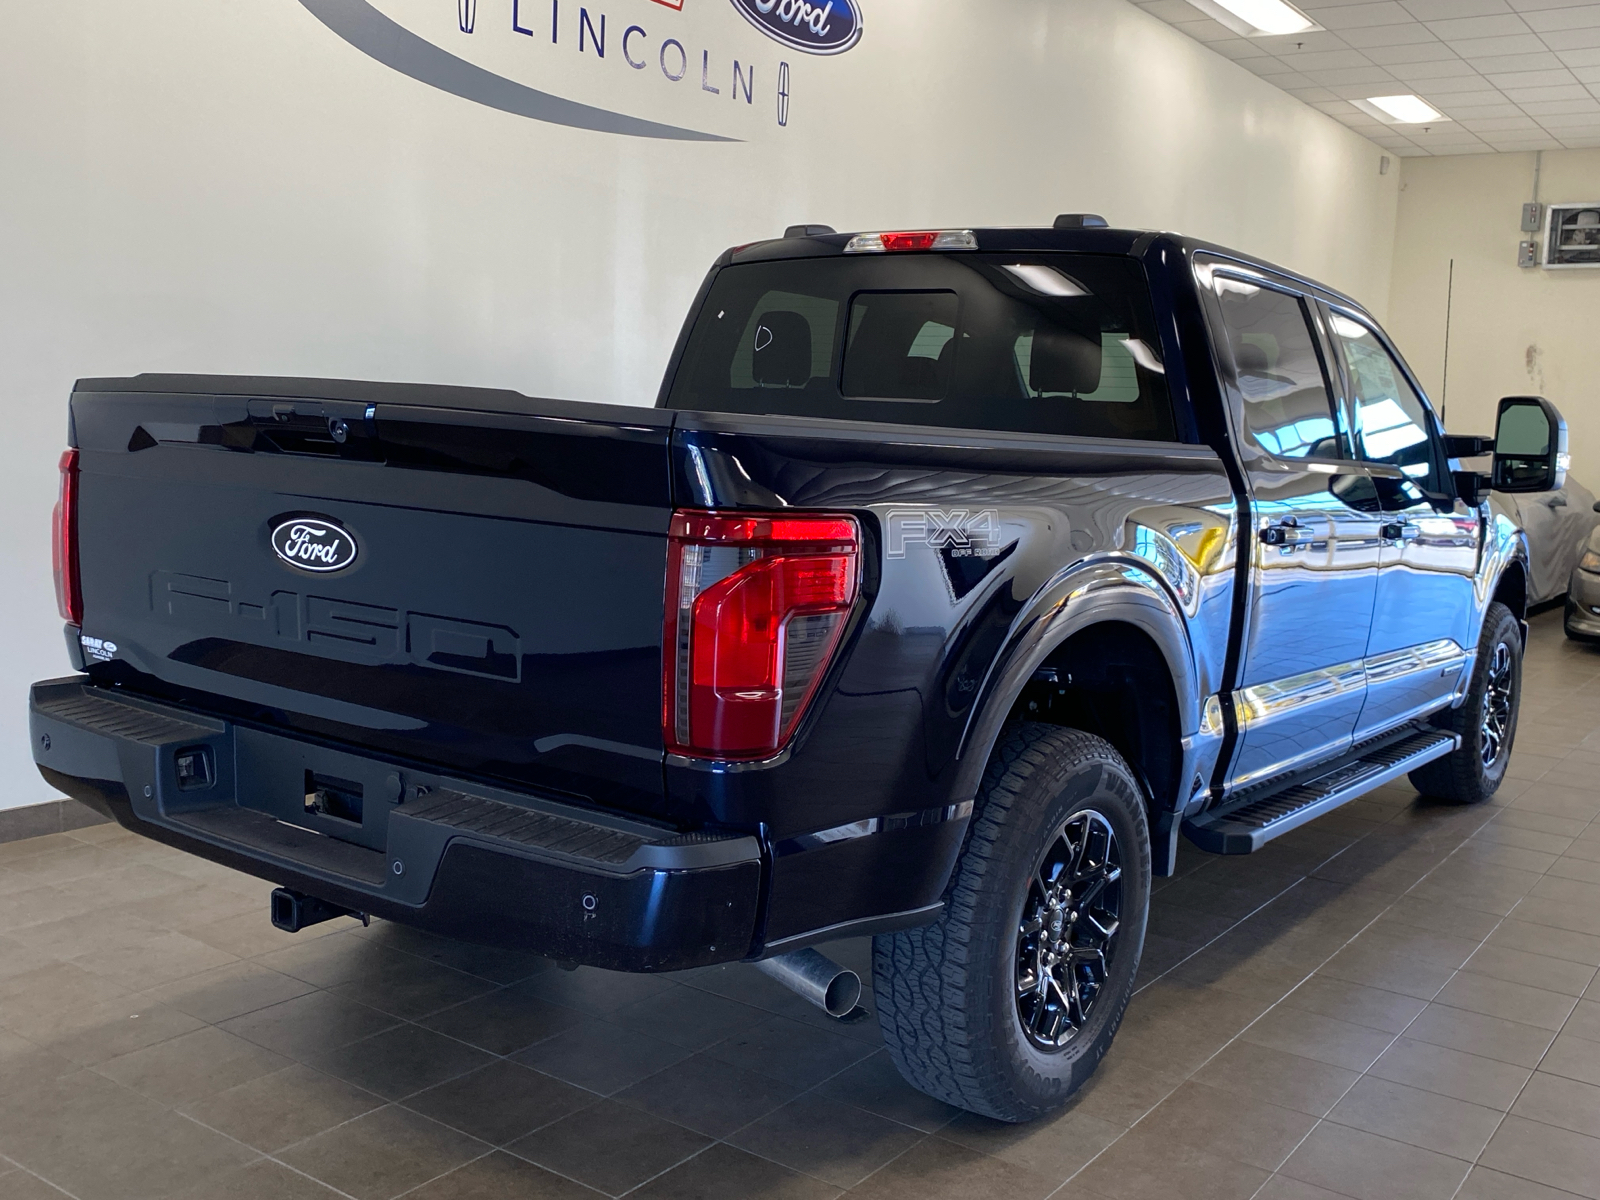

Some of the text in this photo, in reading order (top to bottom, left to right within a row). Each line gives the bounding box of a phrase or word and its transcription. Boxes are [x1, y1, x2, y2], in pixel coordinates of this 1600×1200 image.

[512, 0, 754, 105] LINCOLN
[285, 525, 340, 563] Ford
[886, 509, 1001, 560] FX4
[951, 549, 972, 558] OFF
[149, 569, 522, 683] F-150
[1104, 771, 1150, 890] WRANGLER
